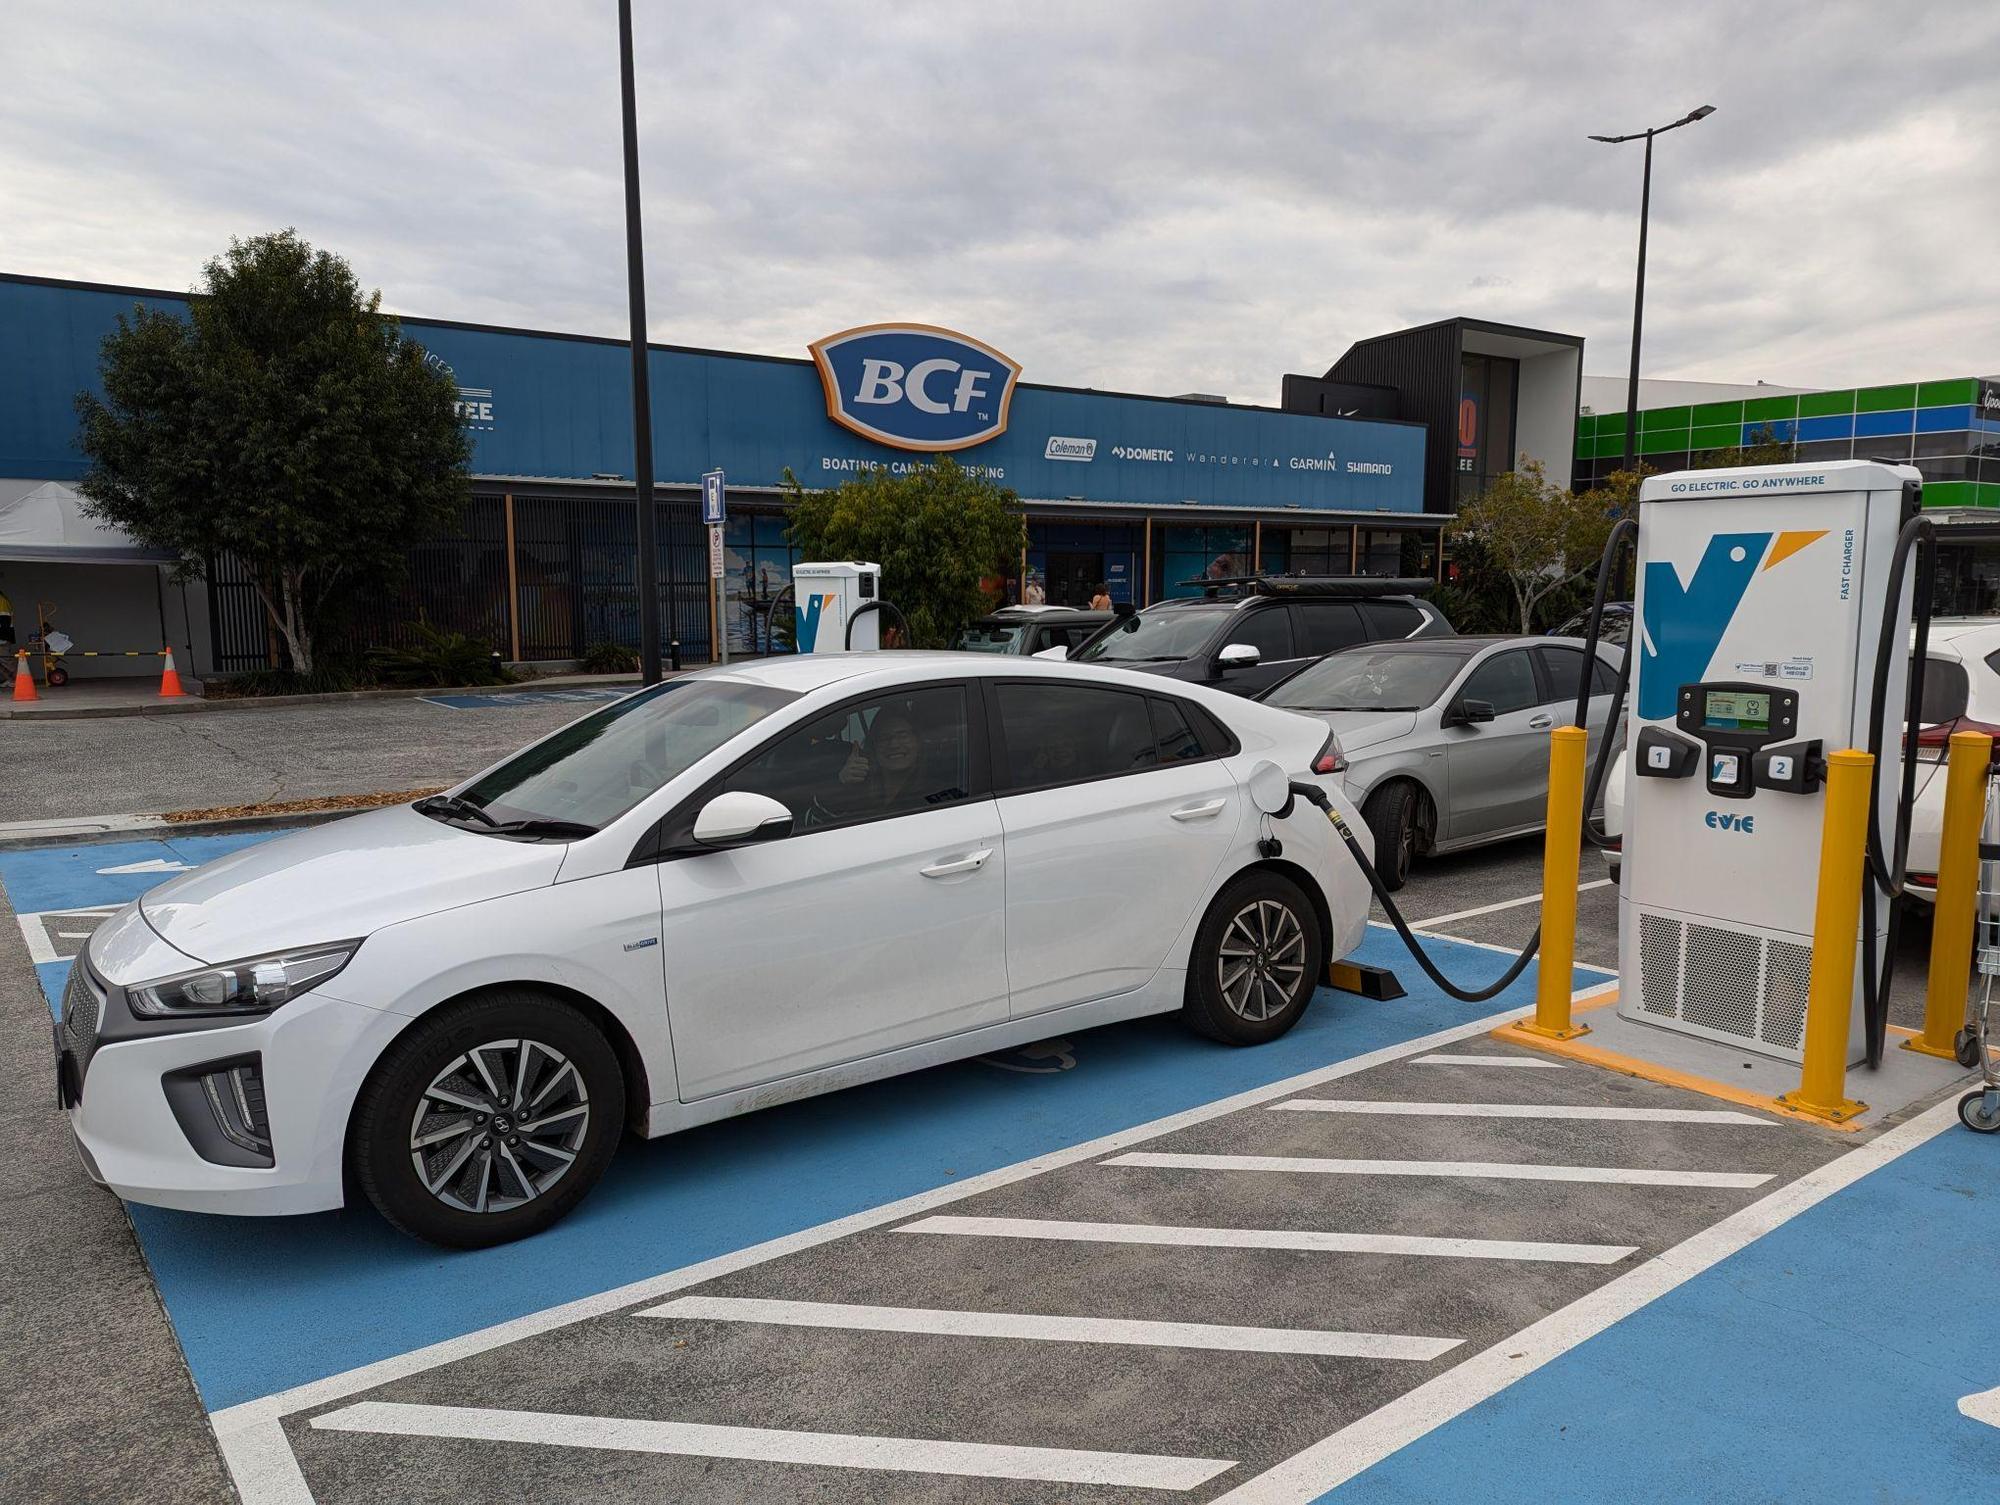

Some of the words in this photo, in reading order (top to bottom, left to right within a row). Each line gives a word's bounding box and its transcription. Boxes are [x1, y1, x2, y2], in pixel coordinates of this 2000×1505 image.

[853, 358, 991, 414] BCF
[1049, 439, 1086, 456] Coleman
[1126, 447, 1174, 462] DOMETIC
[822, 457, 879, 472] BOATING
[1289, 457, 1337, 471] GARMIN
[1347, 462, 1392, 475] SHIMANO
[1671, 483, 1687, 492] GO
[1688, 480, 1740, 492] ELECTRIC.
[1742, 479, 1759, 489] GO
[1761, 475, 1825, 488] ANYWHERE
[1842, 529, 1854, 575] CHARGER
[1840, 577, 1850, 600] FAST
[1655, 752, 1663, 764] 1
[1776, 762, 1785, 774] 2
